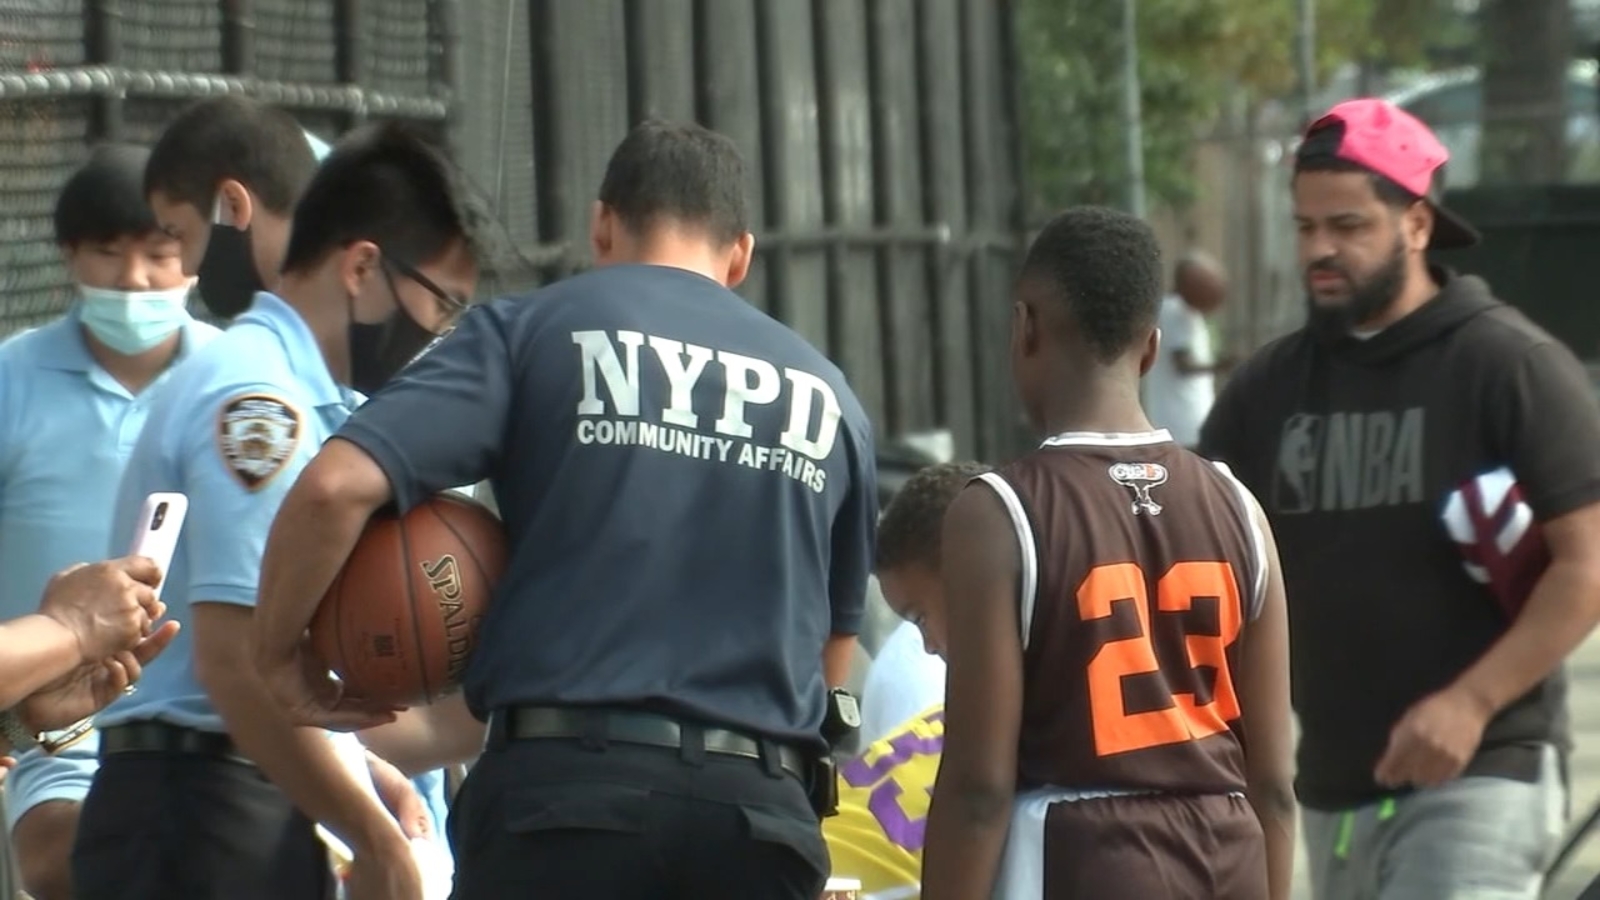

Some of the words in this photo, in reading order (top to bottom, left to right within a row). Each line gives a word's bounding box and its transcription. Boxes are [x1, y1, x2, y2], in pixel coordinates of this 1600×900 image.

[571, 330, 842, 460] NYPD
[577, 419, 733, 462] COMMUNITY
[737, 443, 827, 493] AFFAIRS
[1320, 407, 1426, 512] NBA
[420, 554, 471, 680] SPALD
[1076, 561, 1243, 757] 23
